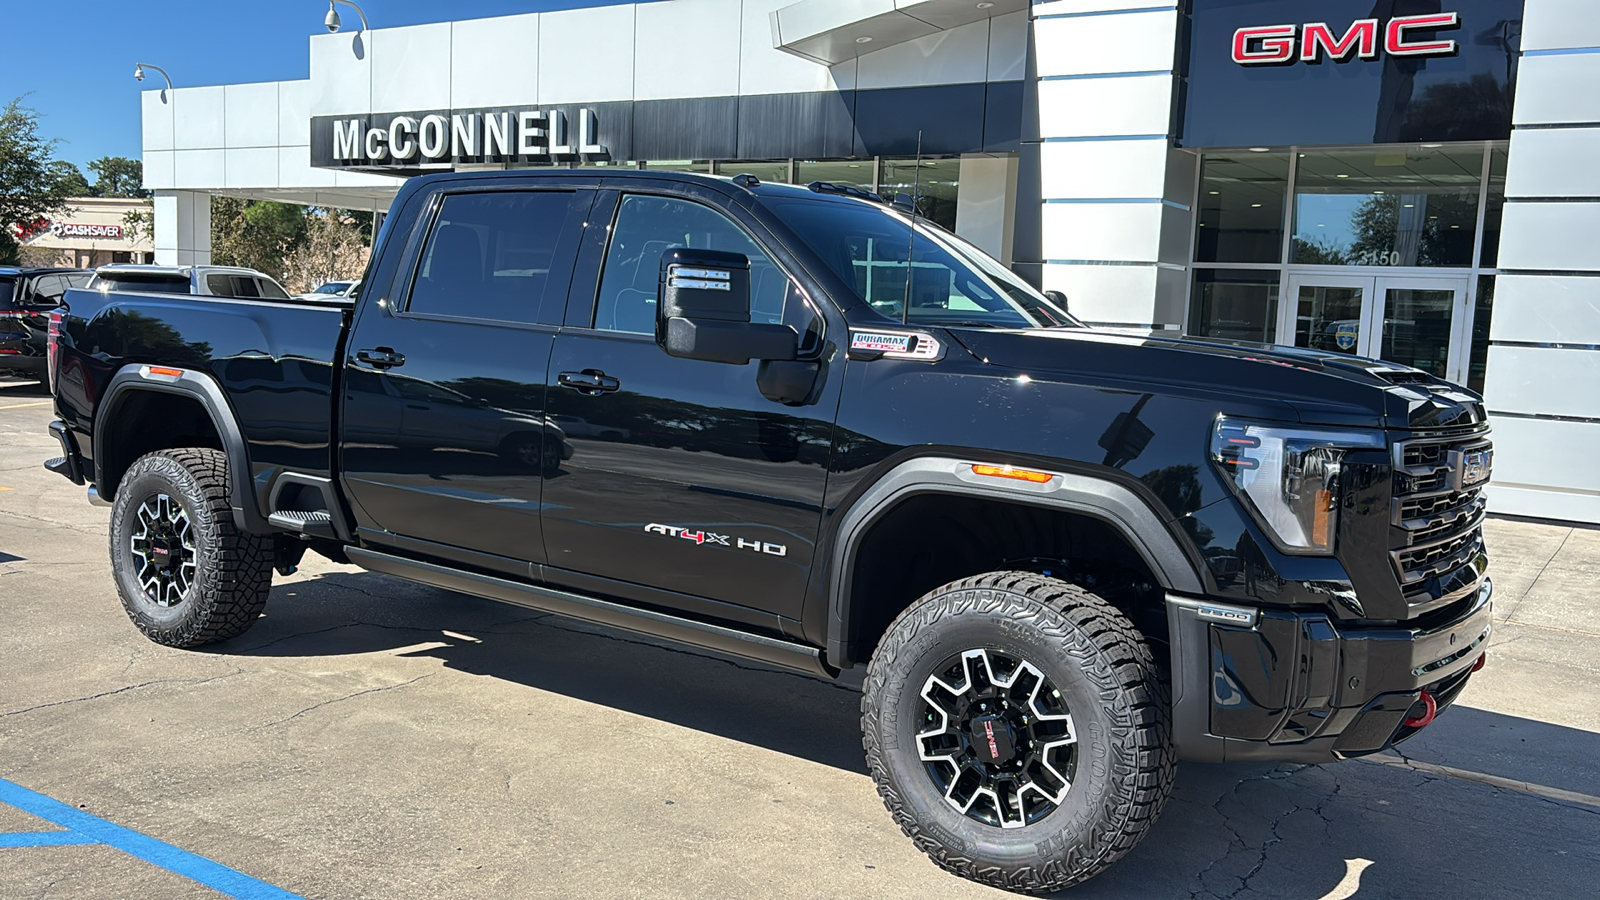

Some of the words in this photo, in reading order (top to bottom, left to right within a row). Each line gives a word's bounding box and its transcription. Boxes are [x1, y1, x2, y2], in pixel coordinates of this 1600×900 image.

[1231, 12, 1457, 63] GMC
[332, 108, 603, 160] McCONNELL
[1358, 250, 1400, 266] 3150
[856, 334, 906, 346] DURAMAX
[644, 522, 731, 545] AT4X
[737, 537, 787, 557] HD
[1200, 608, 1248, 620] 2500
[882, 629, 941, 751] WRANGLER
[983, 720, 999, 759] GMC
[1034, 721, 1107, 859] GOODYEAR
